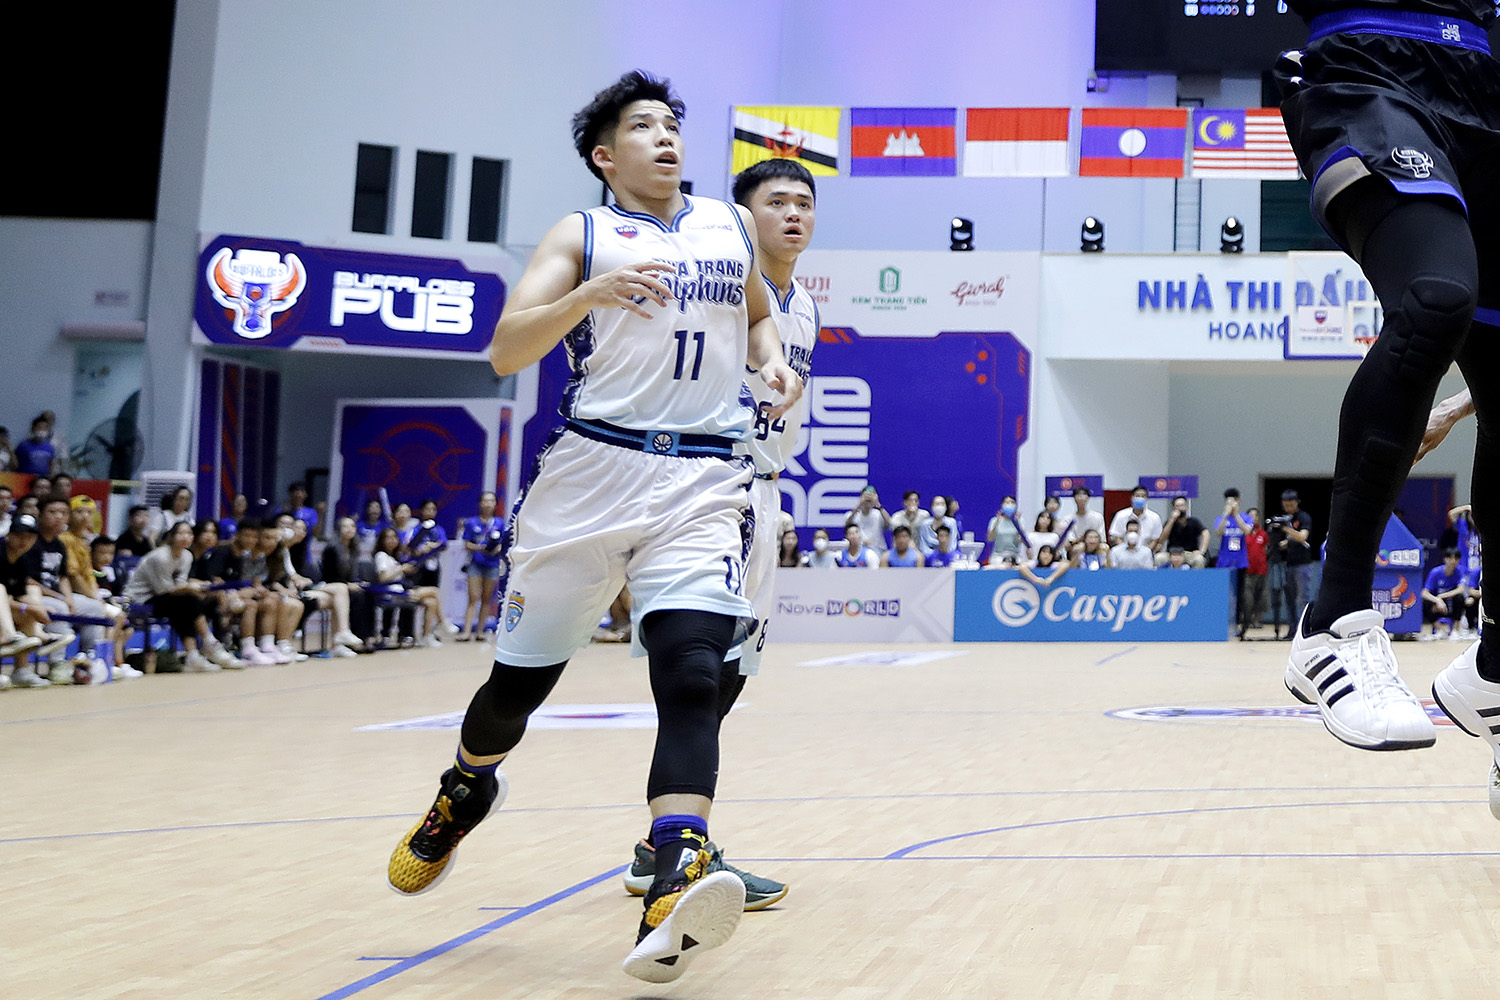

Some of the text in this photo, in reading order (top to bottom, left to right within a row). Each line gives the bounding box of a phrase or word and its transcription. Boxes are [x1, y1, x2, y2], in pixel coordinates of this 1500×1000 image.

[334, 271, 476, 296] BUFFALOES
[695, 259, 744, 279] TRANG
[330, 287, 475, 335] PUB
[1138, 273, 1213, 310] NHÀ
[1226, 281, 1281, 310] THI
[673, 330, 705, 380] 11
[1043, 585, 1190, 632] Casper
